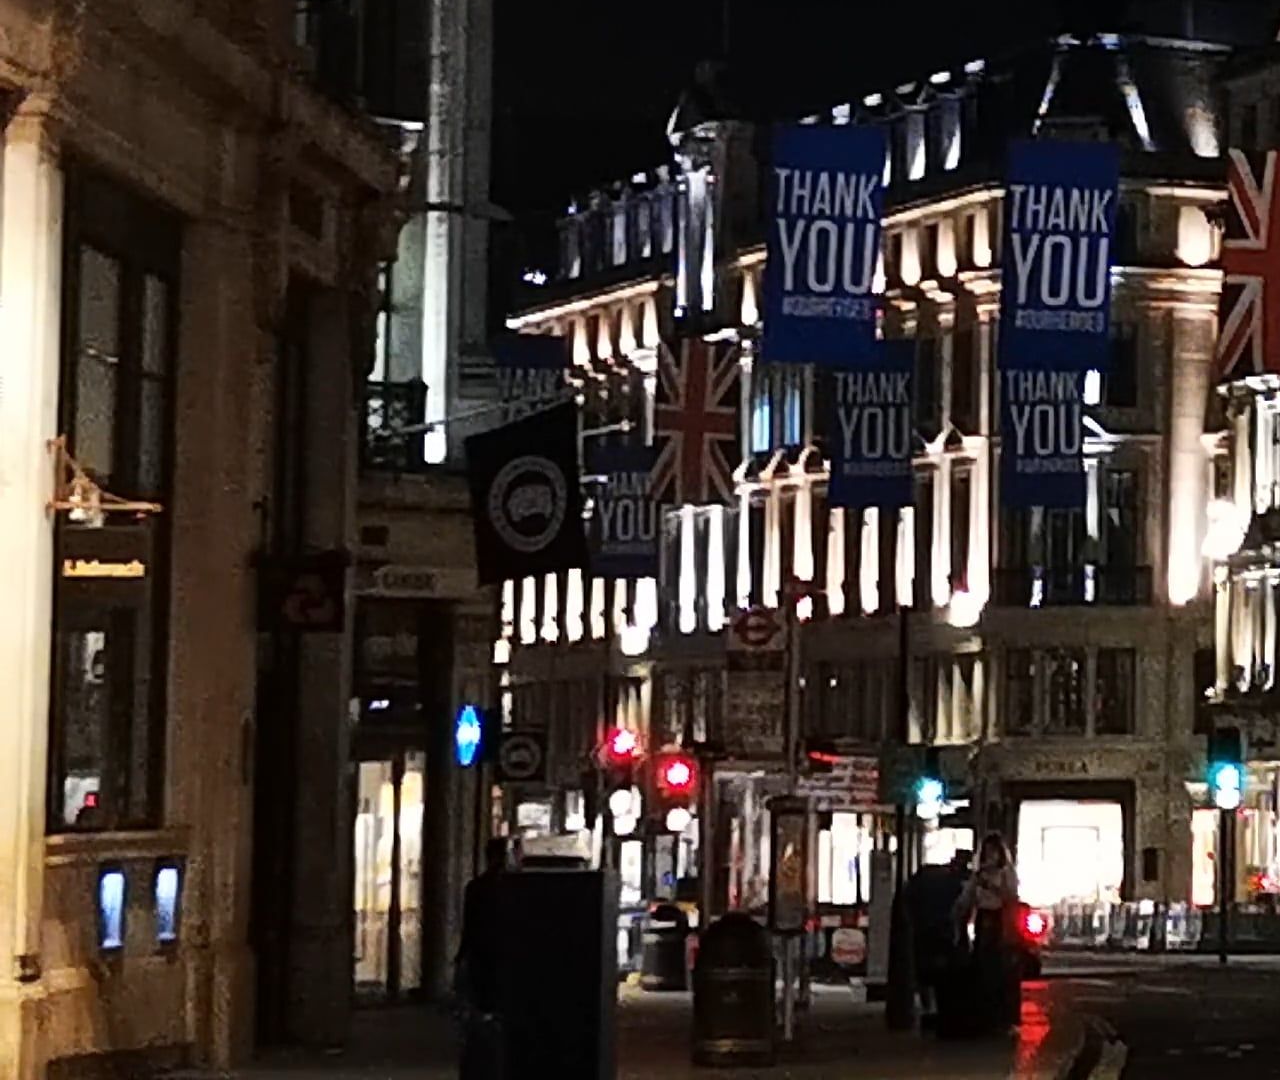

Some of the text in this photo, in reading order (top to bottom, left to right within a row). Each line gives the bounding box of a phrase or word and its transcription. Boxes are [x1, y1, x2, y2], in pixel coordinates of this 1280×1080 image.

[775, 167, 878, 220] THANK
[1009, 183, 1113, 235] THANK
[777, 218, 873, 295] YOU
[1011, 233, 1108, 308] YOU
[833, 372, 910, 404] THANK
[1004, 370, 1079, 402] THANK
[836, 406, 911, 460] YOU
[1010, 404, 1080, 456] YOU
[597, 497, 657, 541] YOU
